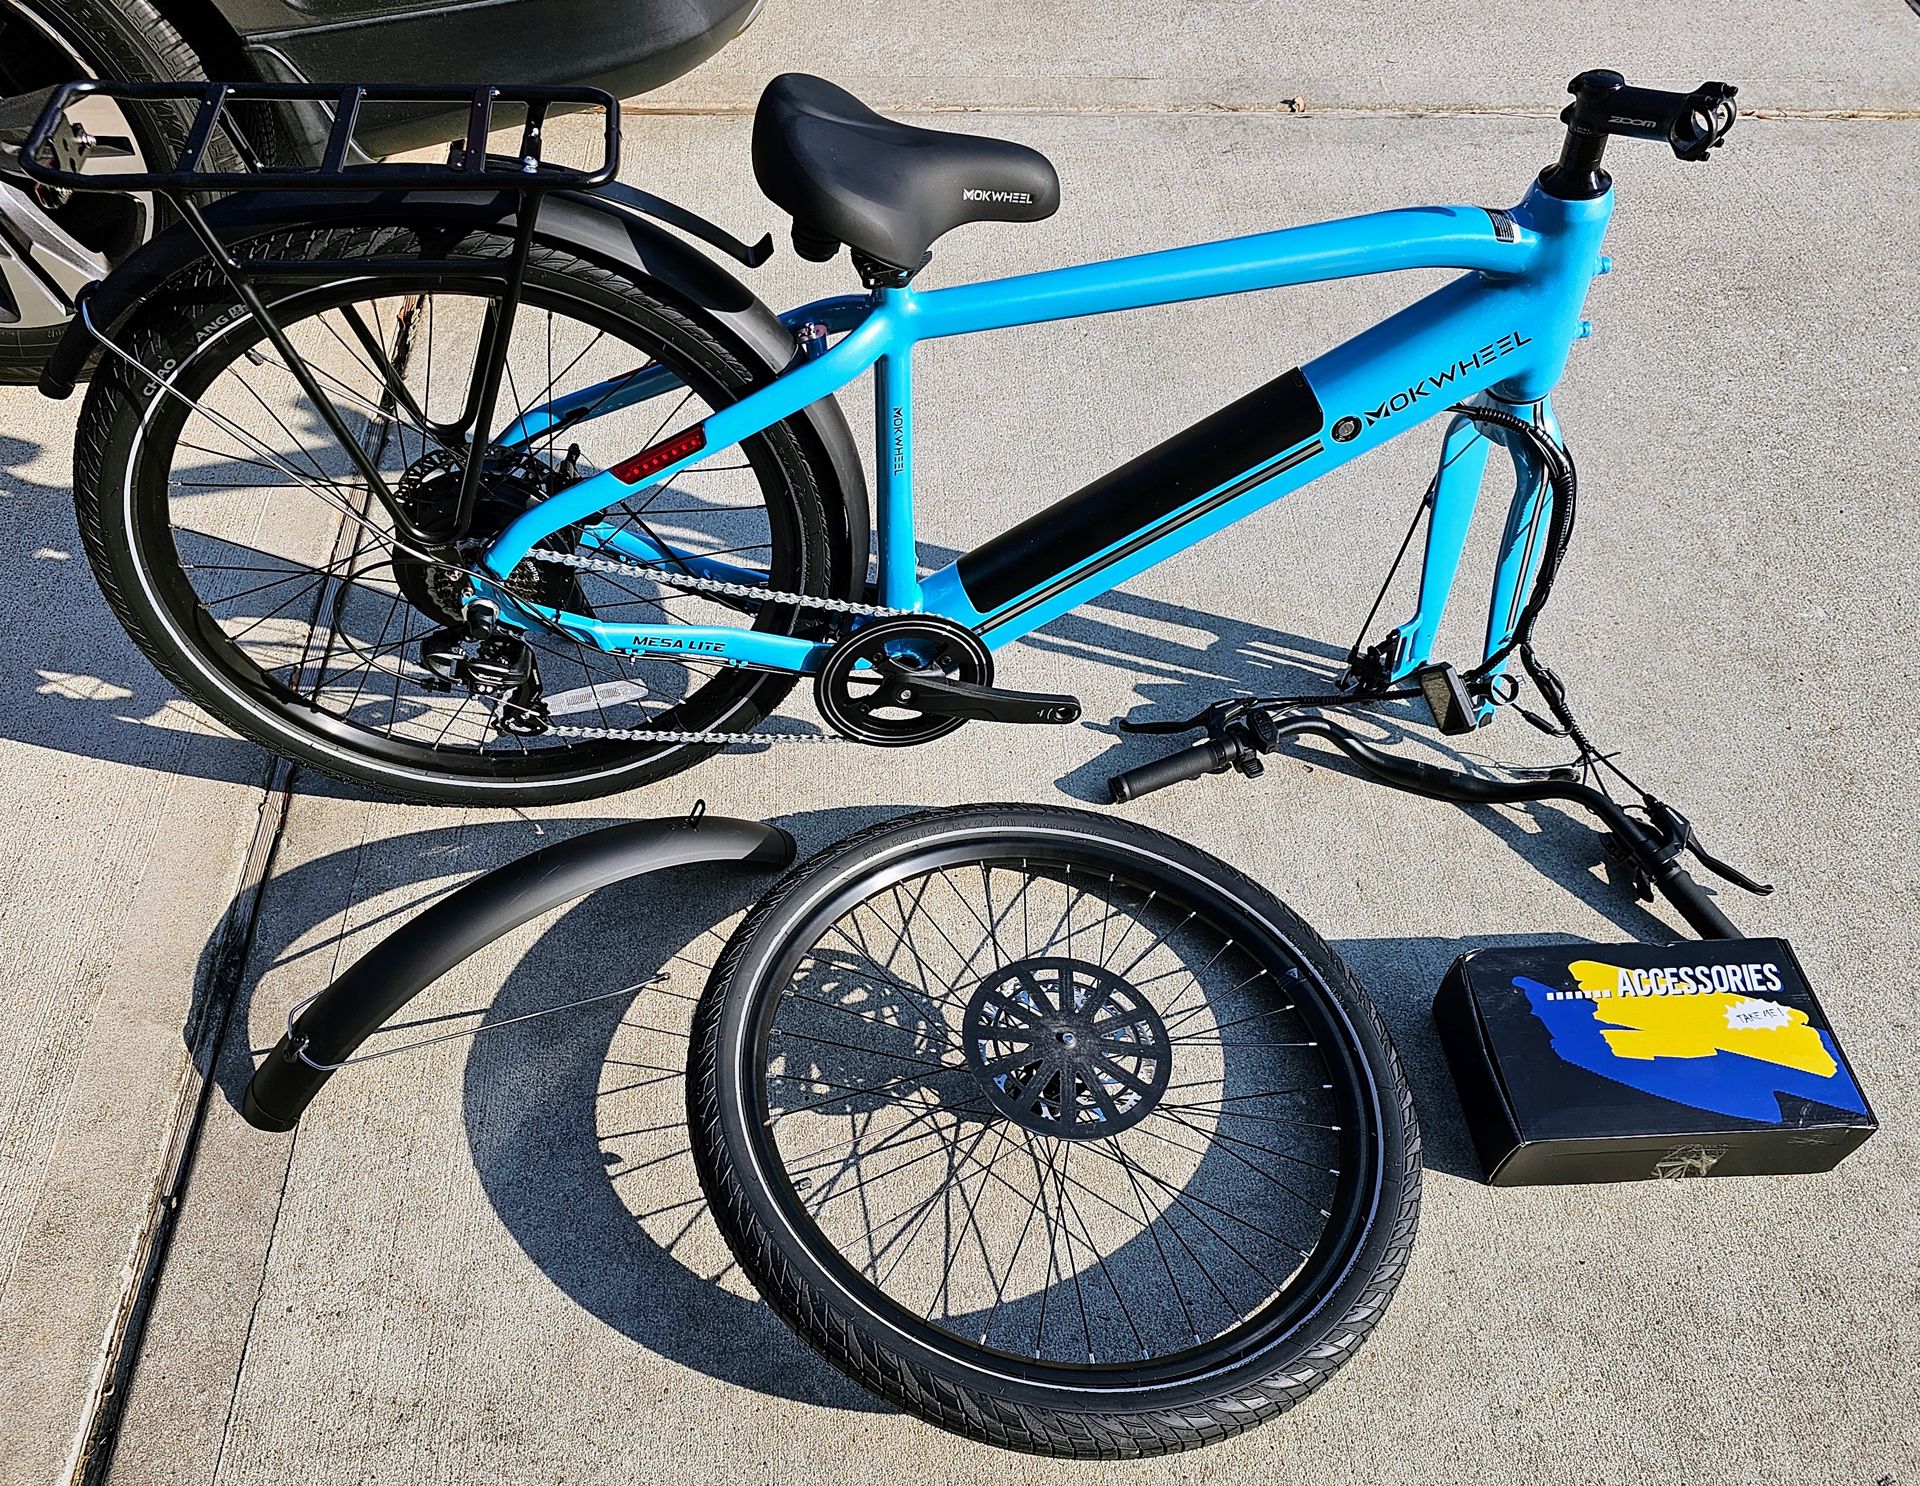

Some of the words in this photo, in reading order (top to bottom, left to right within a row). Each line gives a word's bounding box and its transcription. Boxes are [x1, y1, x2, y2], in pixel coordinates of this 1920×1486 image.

[962, 188, 1033, 204] MOKWHEEL
[1363, 330, 1533, 428] MOKWHEEL
[892, 406, 904, 477] MOKWHEEL
[632, 635, 683, 649] MESA
[688, 640, 726, 653] LITE
[1616, 963, 1784, 998] ACCESSORIES
[1735, 1010, 1763, 1024] TAKE
